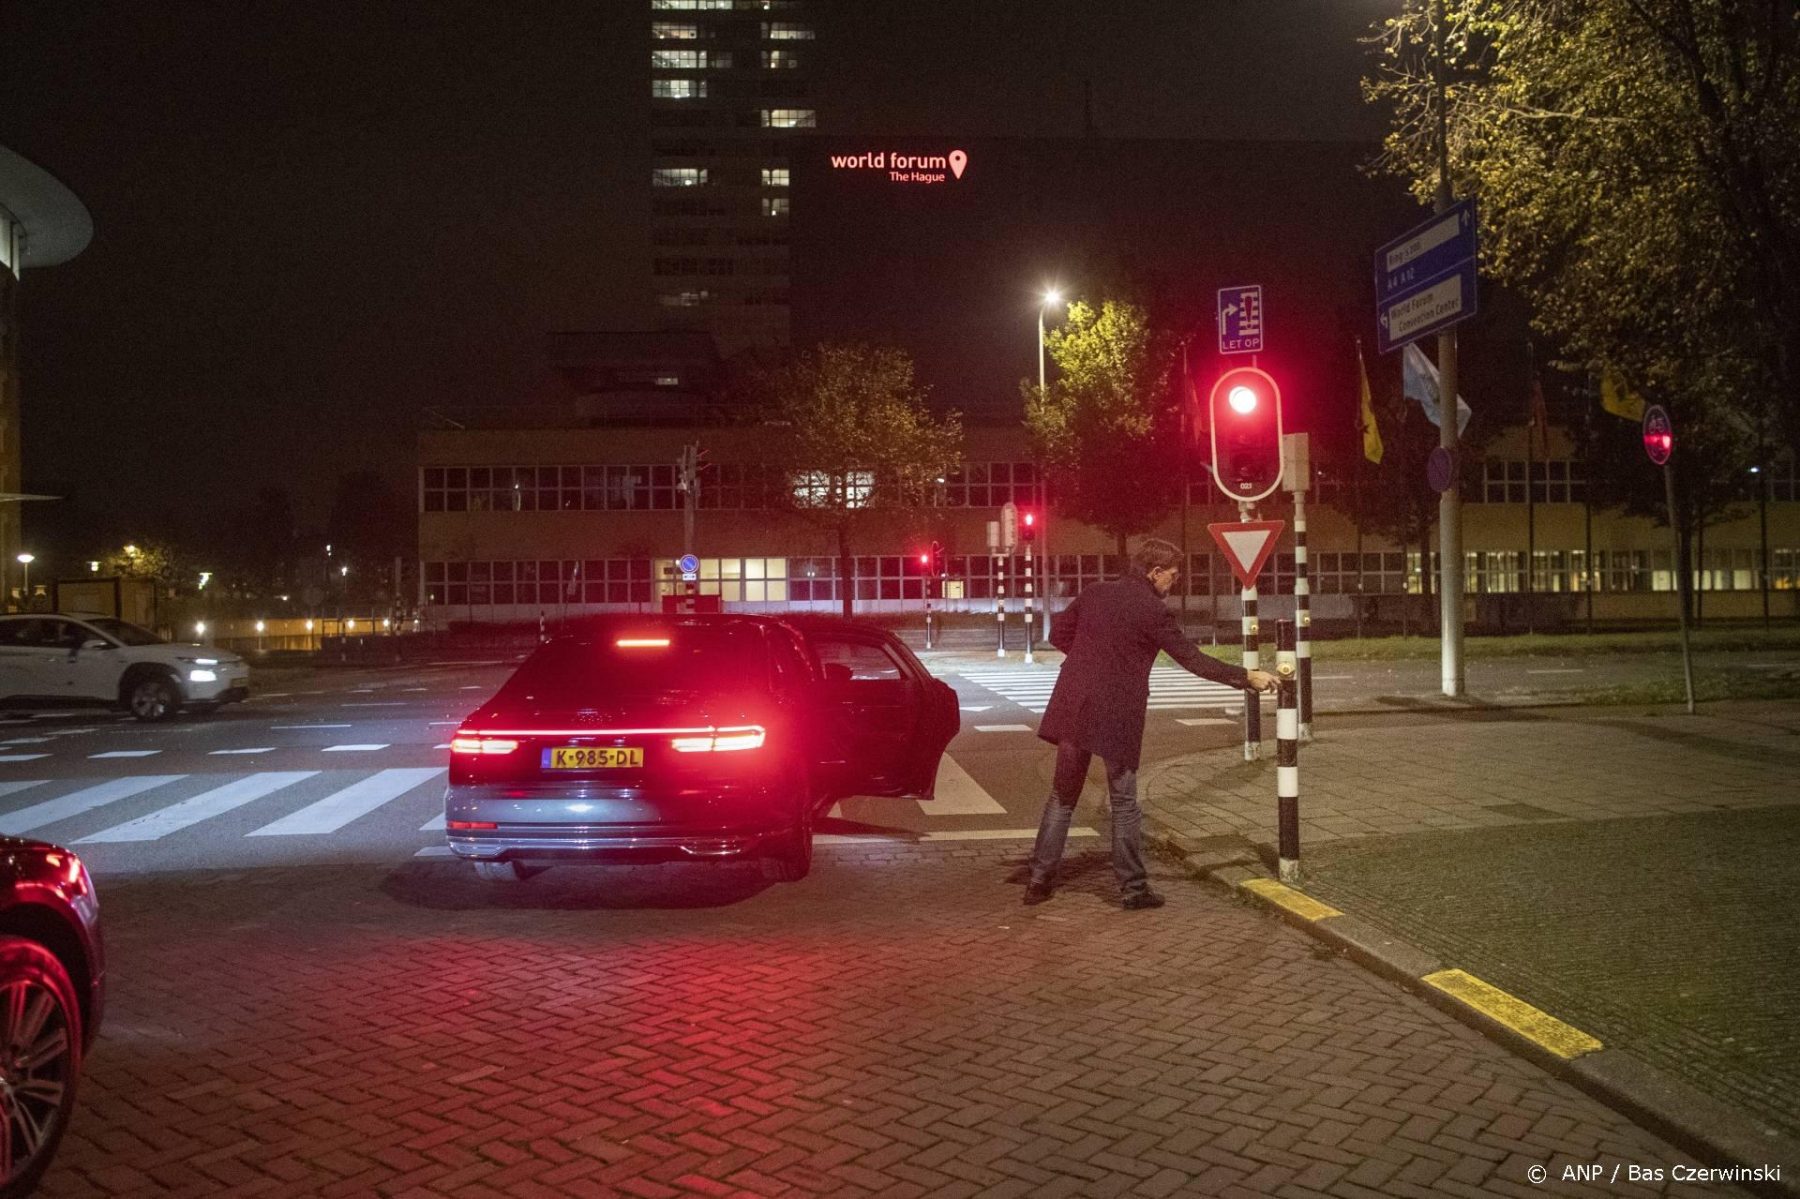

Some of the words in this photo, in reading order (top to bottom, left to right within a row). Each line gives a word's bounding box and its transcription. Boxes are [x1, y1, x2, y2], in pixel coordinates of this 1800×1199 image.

[831, 152, 885, 169] world
[890, 152, 946, 169] forum
[889, 171, 909, 182] The
[911, 171, 945, 184] Hague
[1222, 339, 1241, 350] LET
[1244, 338, 1260, 348] OP
[556, 749, 639, 766] K-985-DL
